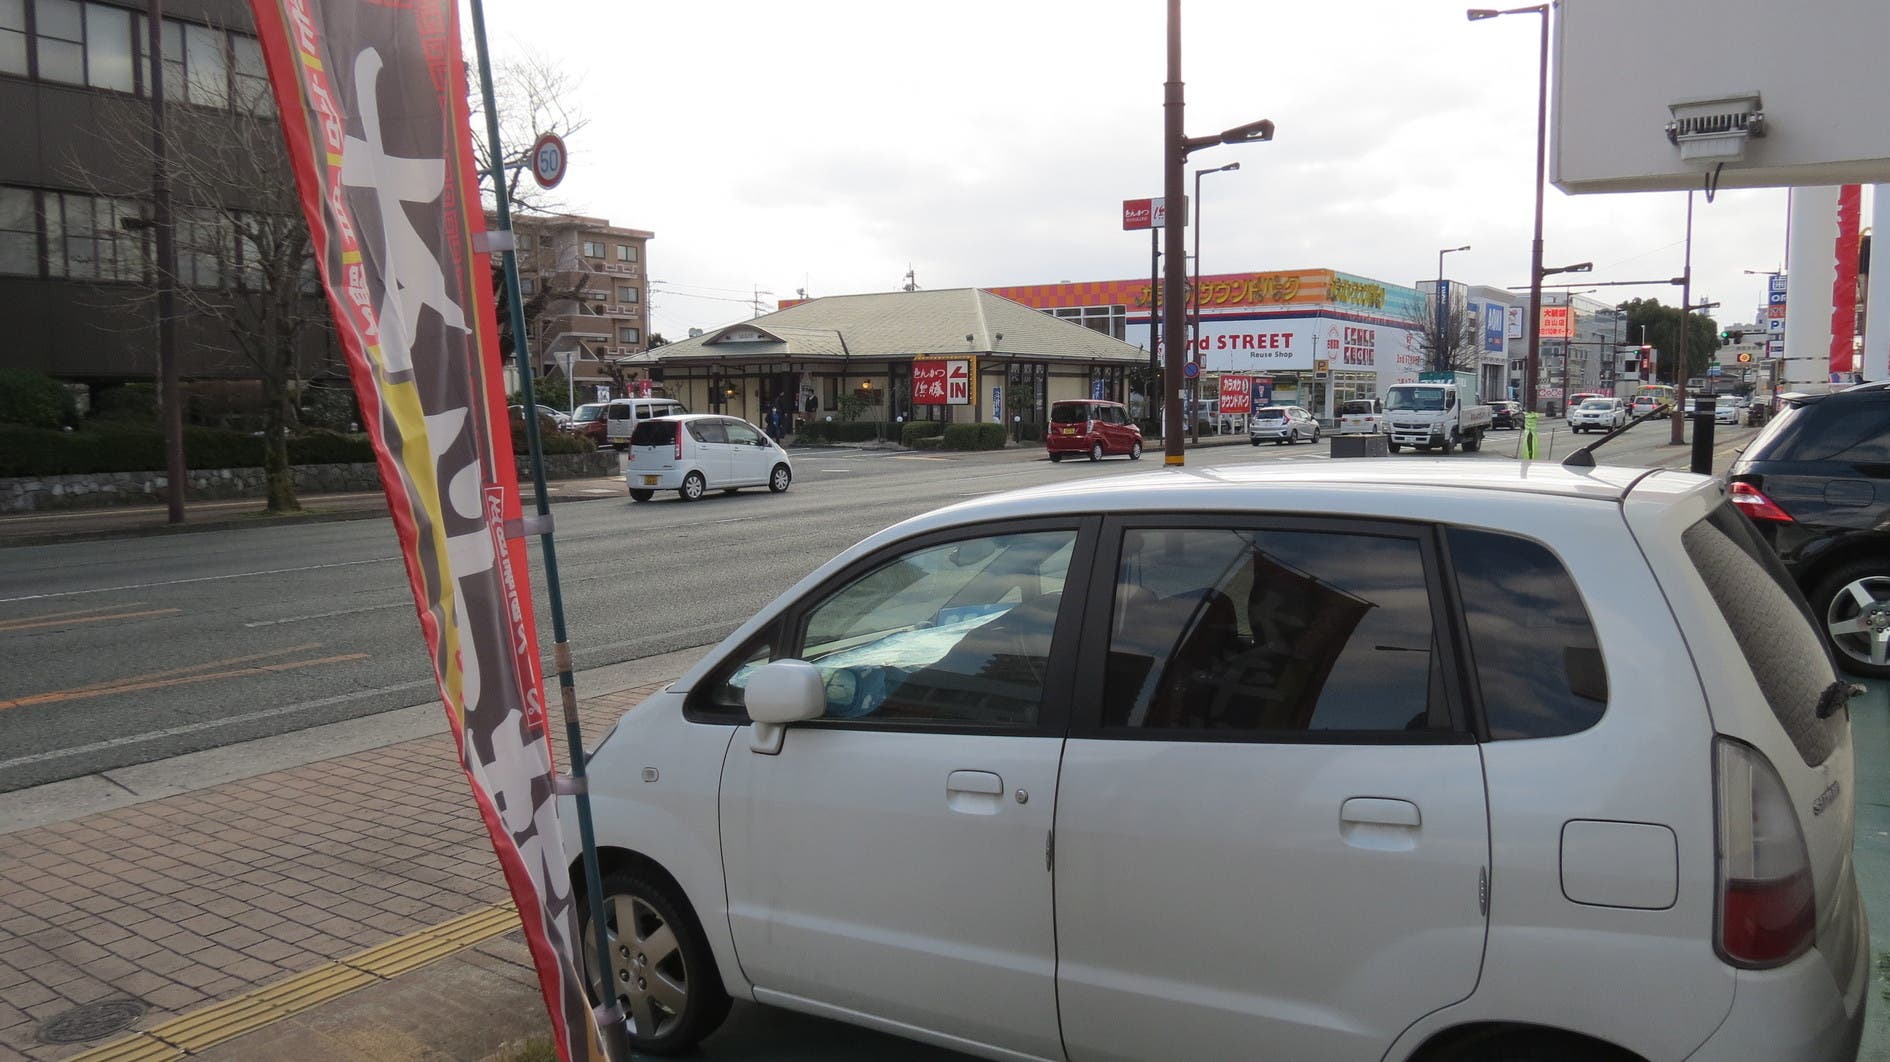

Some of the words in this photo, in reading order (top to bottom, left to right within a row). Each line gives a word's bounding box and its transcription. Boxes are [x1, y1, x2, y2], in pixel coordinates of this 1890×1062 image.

[540, 149, 558, 173] 50
[1217, 332, 1294, 350] STREET
[1250, 351, 1273, 359] Reuse
[1274, 351, 1294, 359] Shop
[1317, 361, 1327, 371] P
[913, 367, 946, 379] とんかつ
[950, 382, 967, 398] IN
[1223, 378, 1242, 391] カラオケ
[1221, 394, 1249, 408] サウンドパーク
